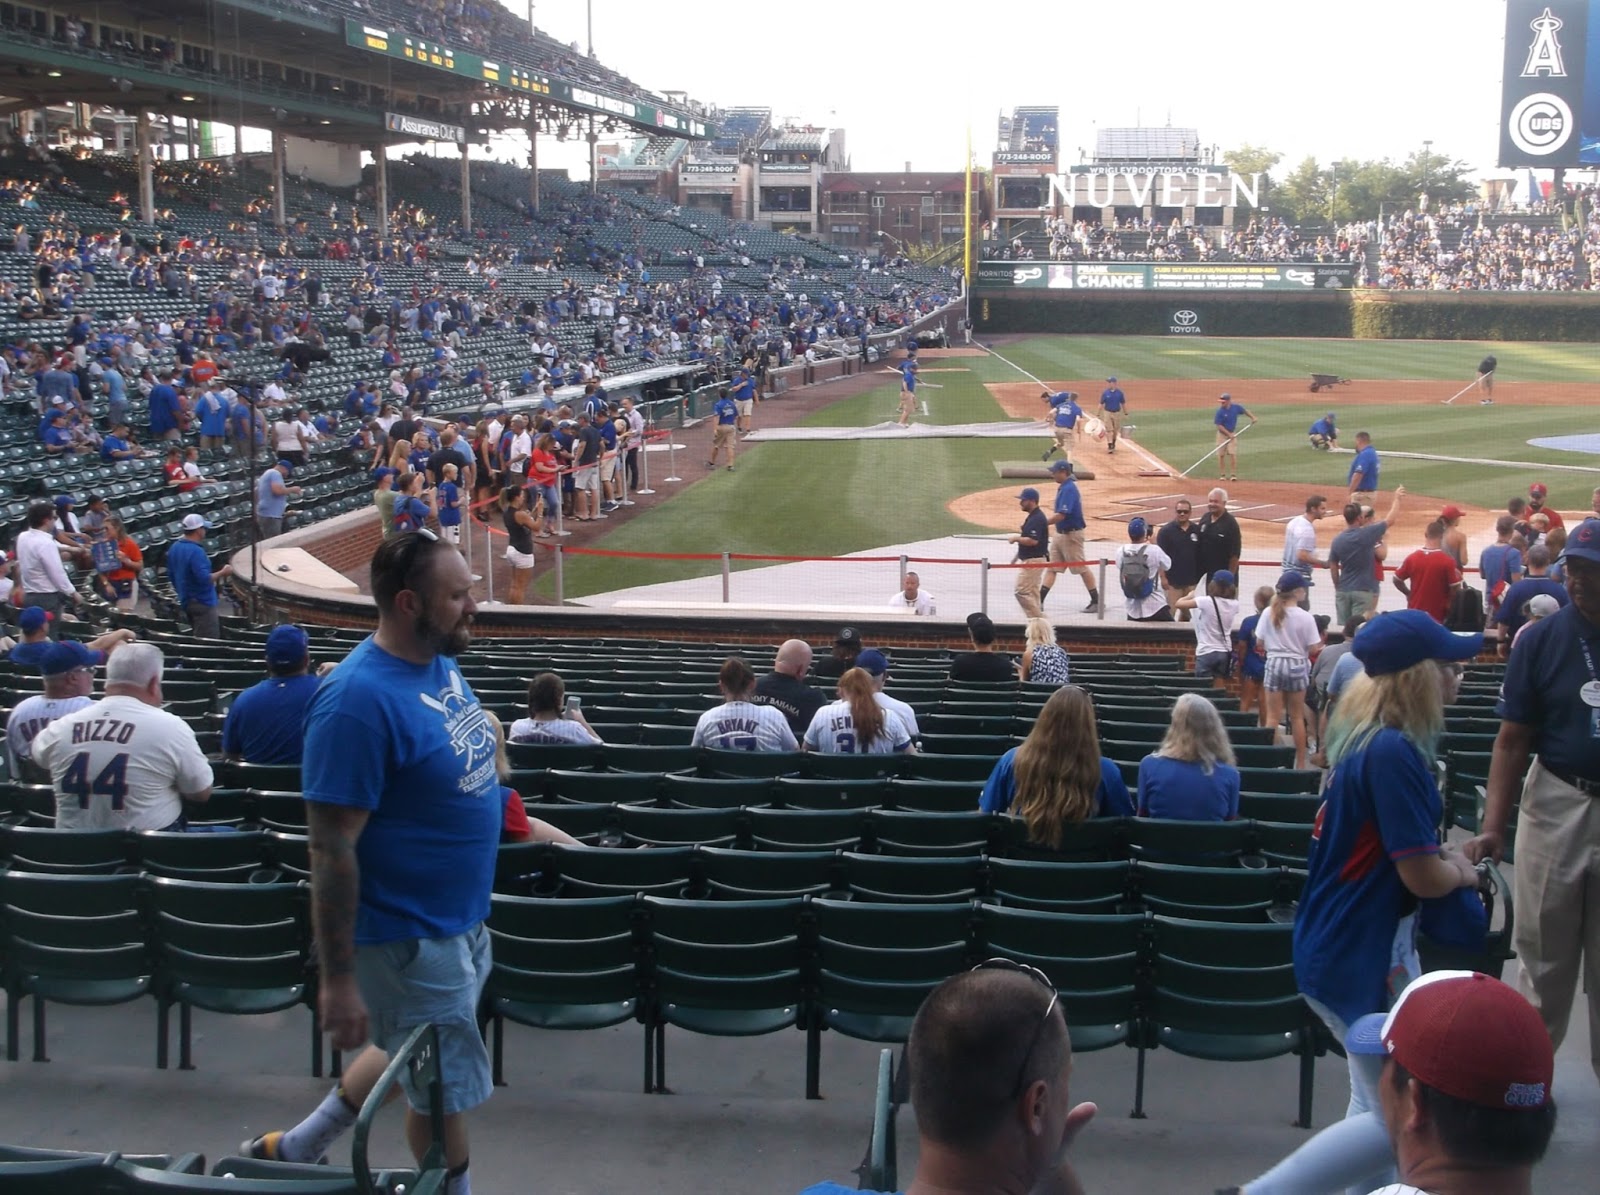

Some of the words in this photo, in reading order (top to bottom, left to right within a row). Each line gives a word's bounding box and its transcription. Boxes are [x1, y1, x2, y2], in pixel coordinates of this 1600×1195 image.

[400, 117, 439, 138] Assurance
[440, 124, 455, 140] Club
[1046, 173, 1262, 208] NUVEEN
[1077, 275, 1144, 288] CHANCE
[769, 696, 800, 717] BAHAMA
[72, 719, 136, 744] RIZZO
[717, 718, 759, 734] BRYANT
[61, 751, 130, 810] 44
